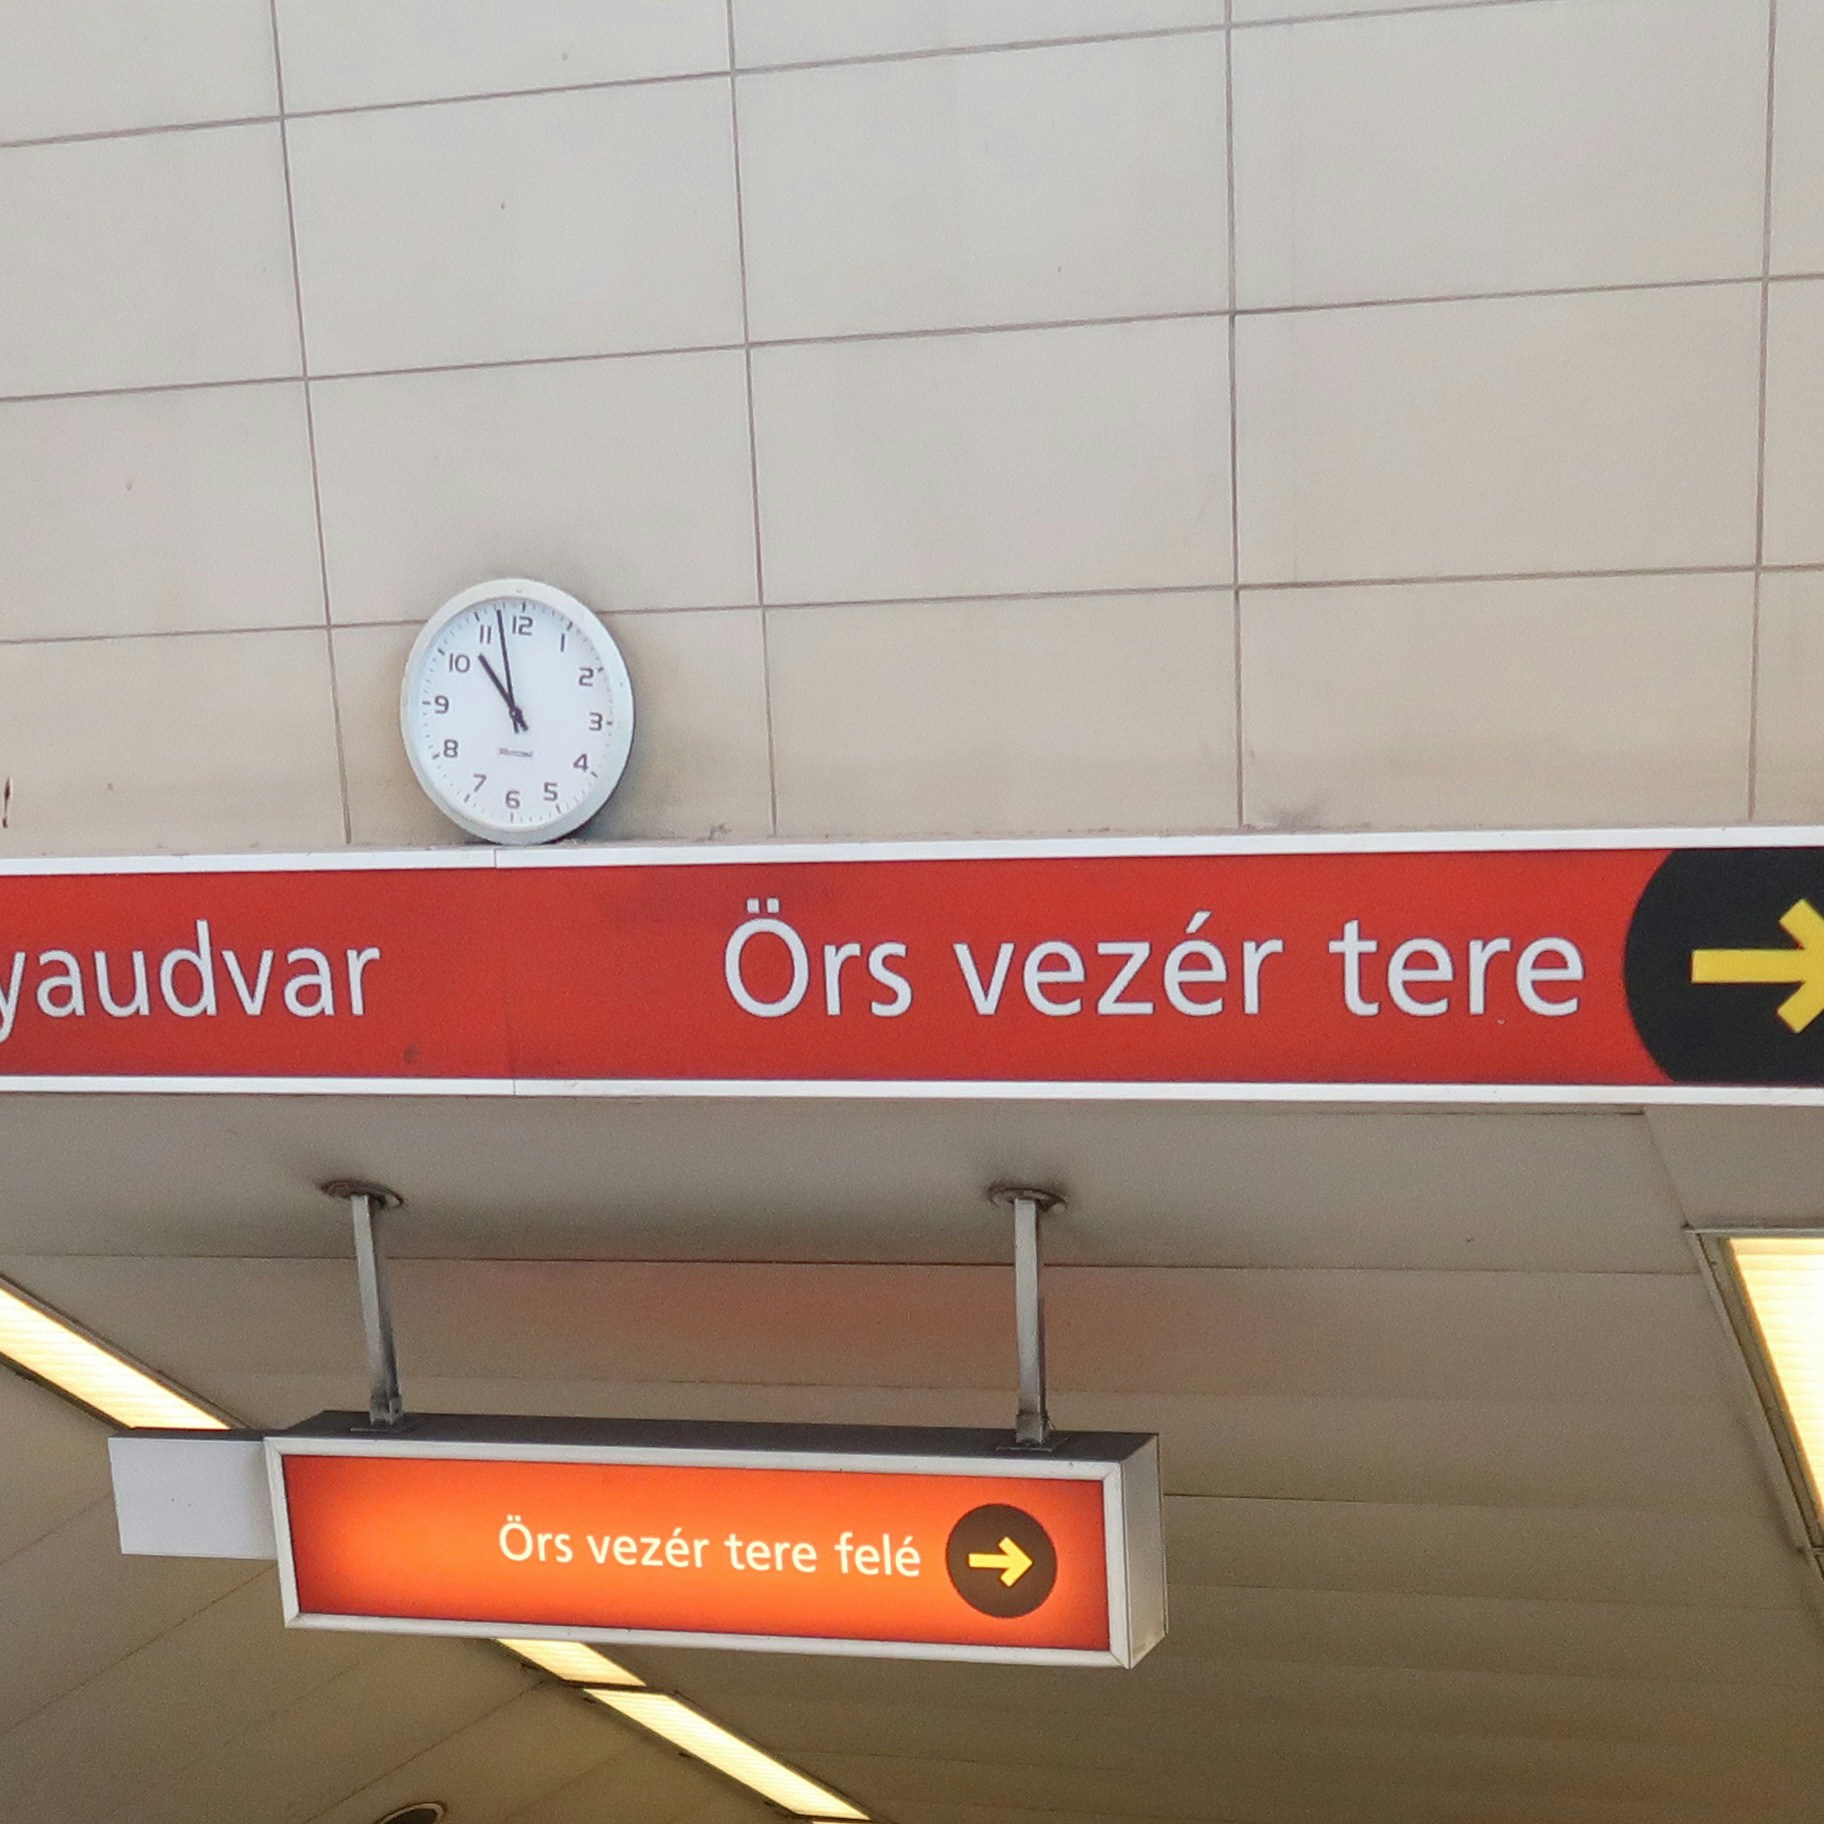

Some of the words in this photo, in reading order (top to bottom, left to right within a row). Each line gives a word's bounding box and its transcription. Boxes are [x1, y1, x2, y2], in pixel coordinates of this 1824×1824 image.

[479, 625, 492, 645] 11
[512, 616, 533, 636] 12
[448, 653, 471, 673] 10
[578, 667, 594, 687] 2
[434, 695, 450, 714] 9
[588, 712, 603, 731] 3
[443, 739, 459, 758] 8
[573, 753, 589, 772] 4
[473, 774, 487, 793] 7
[543, 782, 558, 801] 5
[505, 790, 521, 809] 6
[724, 898, 913, 1018] Örs
[952, 911, 1284, 1016] vezér
[1328, 919, 1585, 1018] tere
[498, 1514, 573, 1563] Örs
[586, 1528, 710, 1569] vezér
[723, 1533, 817, 1573] tere
[834, 1532, 921, 1578] felé
